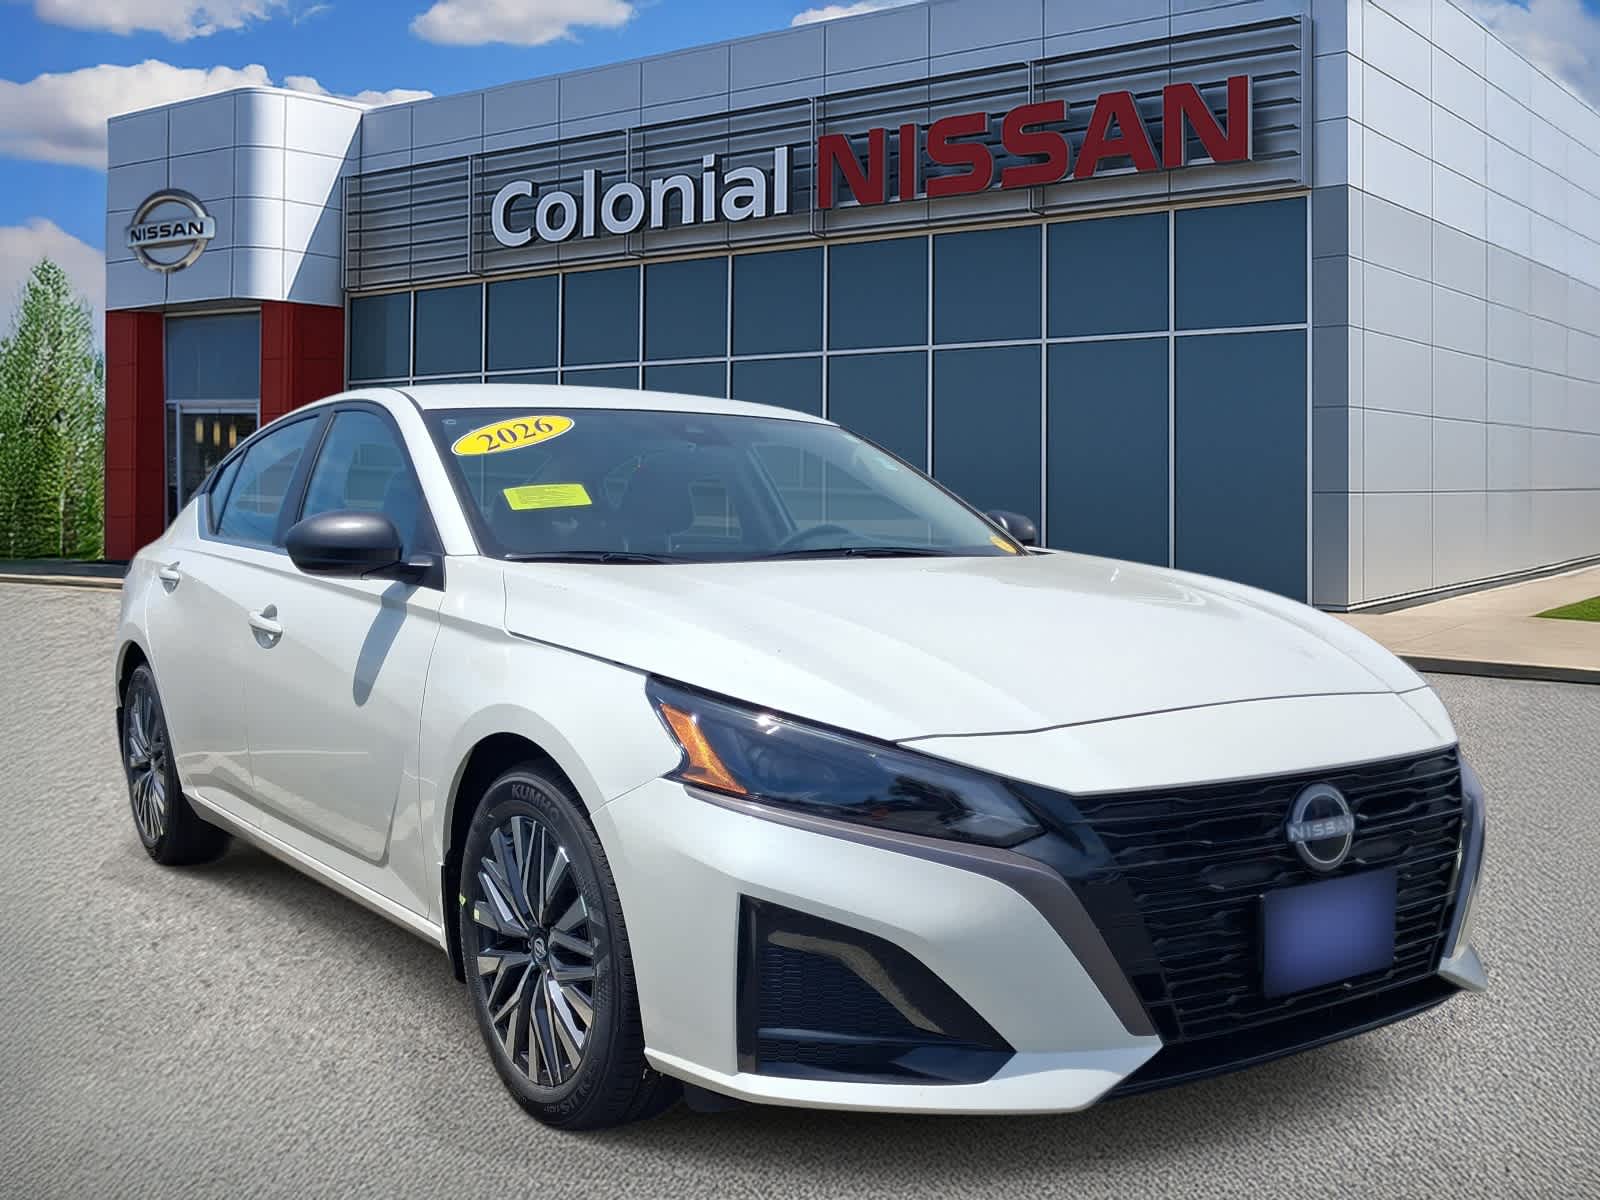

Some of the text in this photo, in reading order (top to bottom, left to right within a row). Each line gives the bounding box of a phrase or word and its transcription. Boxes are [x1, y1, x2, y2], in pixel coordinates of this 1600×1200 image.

[491, 74, 1255, 247] Colonial NISSAN
[130, 221, 204, 242] NISSAN
[477, 418, 553, 451] 2026
[511, 784, 561, 819] KUMHO
[1288, 818, 1351, 840] NISS
